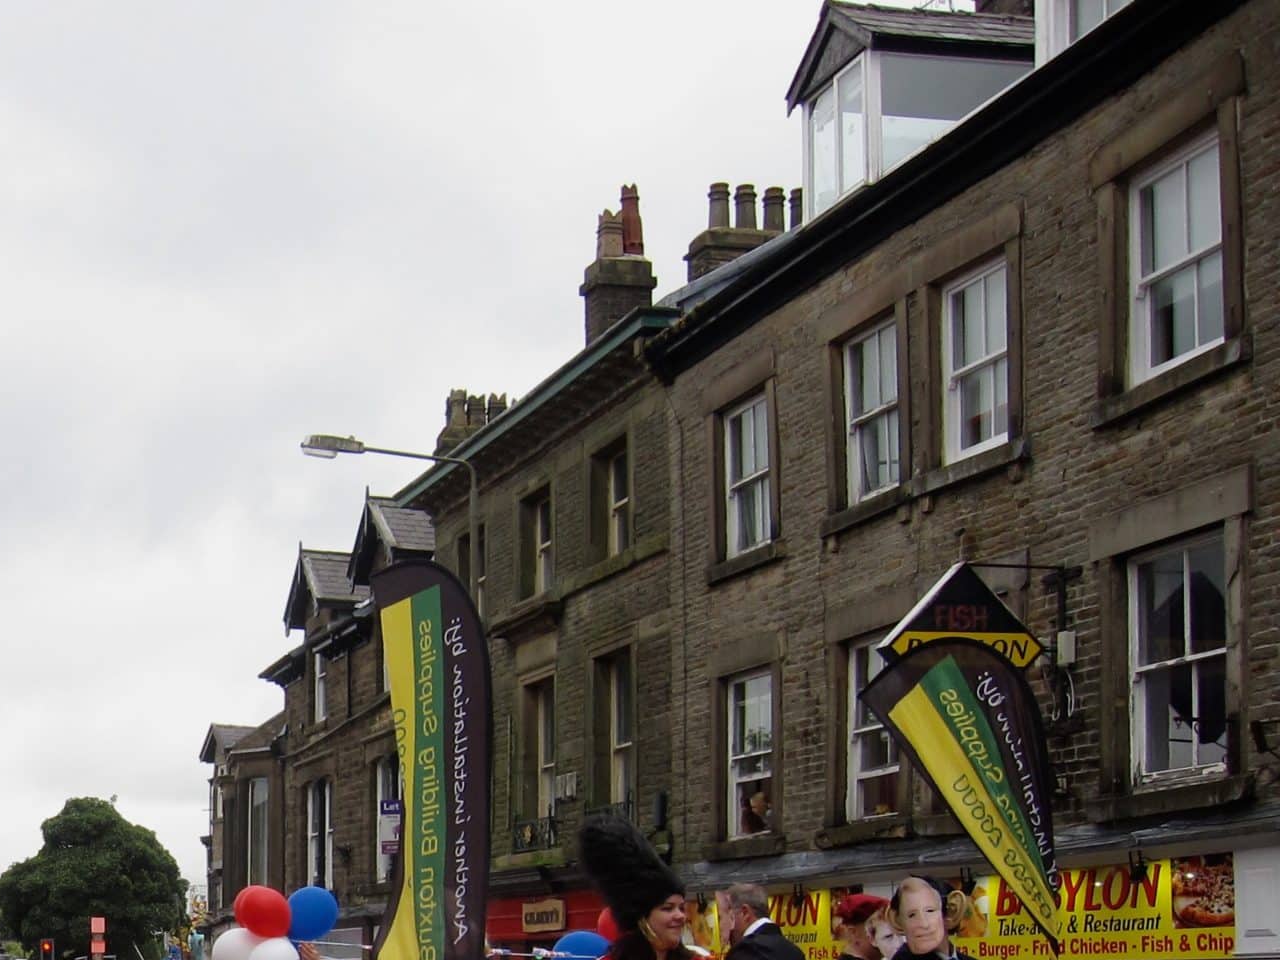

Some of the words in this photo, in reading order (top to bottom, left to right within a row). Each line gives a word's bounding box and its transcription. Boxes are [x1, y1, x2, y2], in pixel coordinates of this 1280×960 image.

[935, 605, 988, 631] FISH
[995, 864, 1162, 917] BYLON
[1066, 916, 1078, 934] &
[1083, 913, 1162, 933] Restaurant
[809, 946, 829, 960] Fish
[978, 941, 1021, 960] Burger
[1032, 938, 1066, 956] Frid
[1070, 936, 1128, 955] Chicken
[1141, 934, 1173, 953] Fish
[1179, 934, 1191, 952] &
